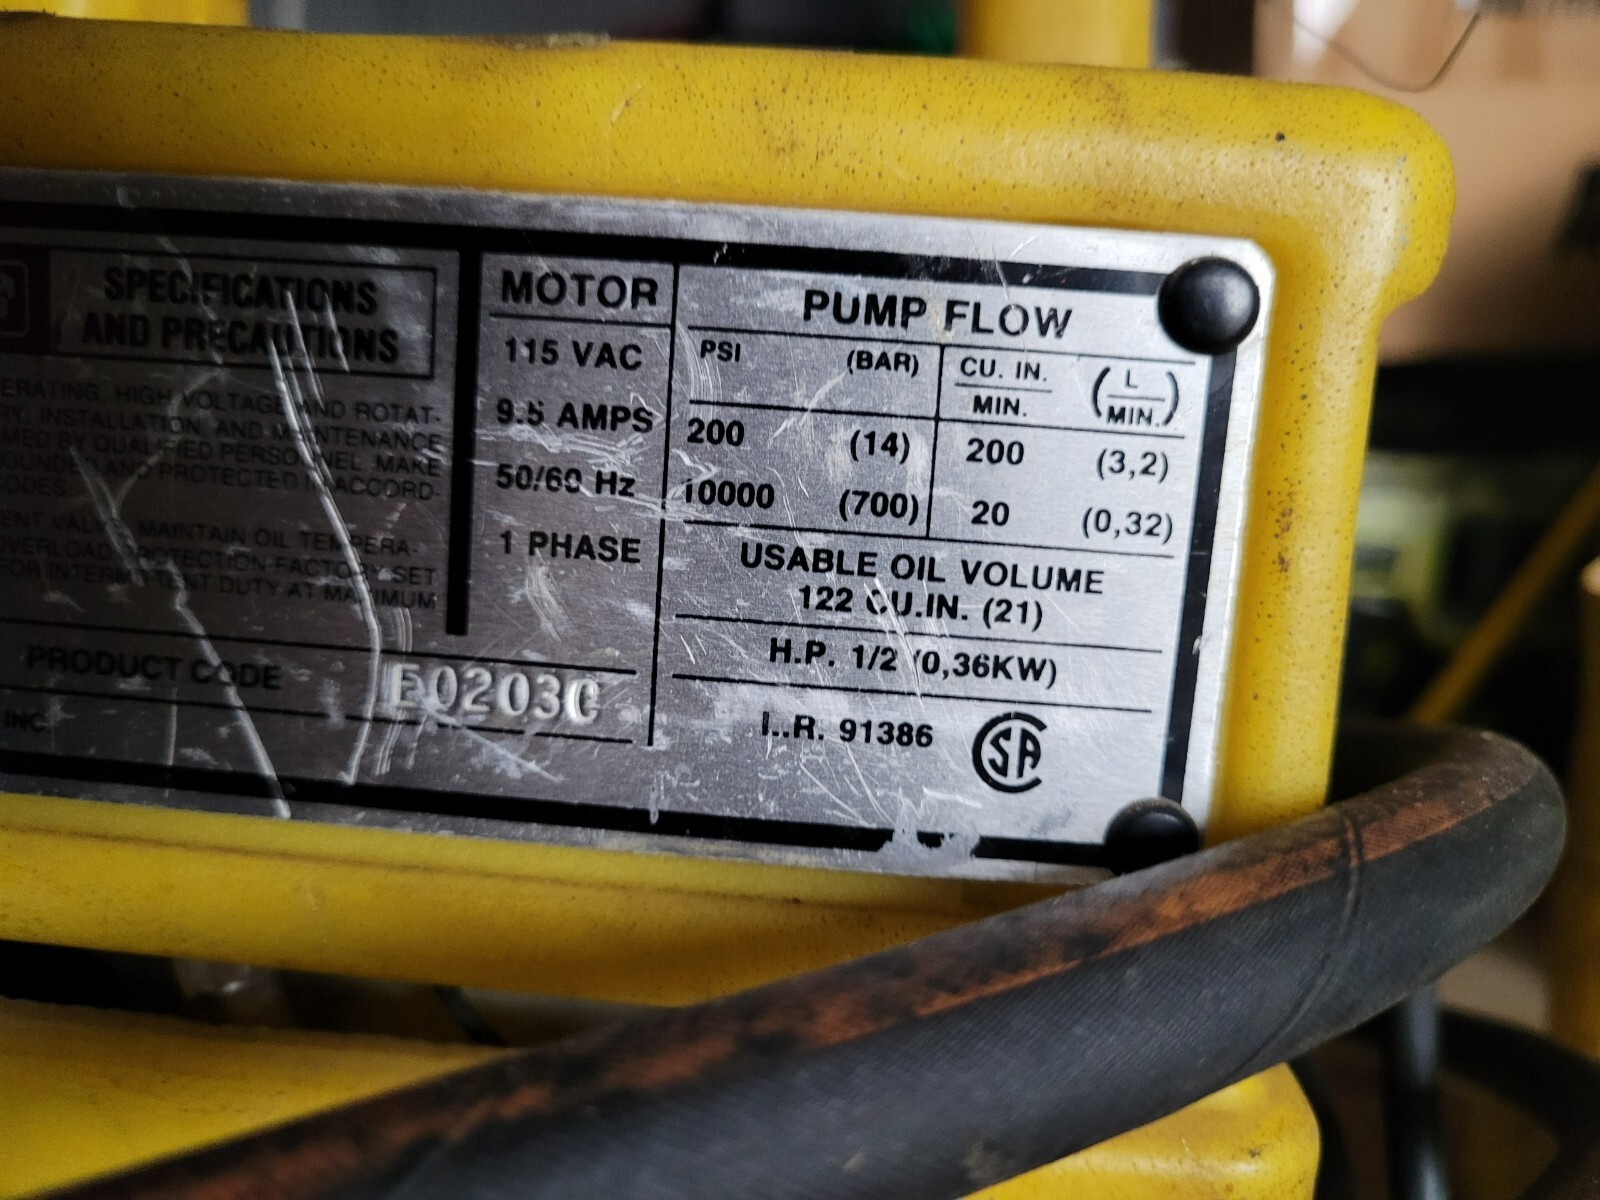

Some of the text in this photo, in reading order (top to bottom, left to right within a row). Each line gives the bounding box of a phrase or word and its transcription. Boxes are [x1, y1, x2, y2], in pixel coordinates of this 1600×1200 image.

[104, 266, 378, 315] SPECIFICATIONS
[501, 271, 658, 310] MOTOR
[803, 289, 1073, 339] PUMP FLOW
[82, 312, 399, 363] AND PRECAUTIONS
[505, 337, 642, 370] 115 VAC
[699, 340, 741, 362] PSI
[846, 349, 920, 377] (BAR)
[959, 357, 1047, 381] CU. IN.
[115, 385, 172, 407] HIGH
[182, 389, 288, 416] VOLTAGE
[355, 402, 440, 424] ROTAT-
[497, 398, 654, 434] 9.5 AMPS
[972, 395, 1027, 417] MIN.
[40, 407, 201, 435] INSTALLATION
[216, 418, 263, 440] AND
[272, 423, 441, 454] MNTENANCE
[687, 419, 911, 464] 200 (14)
[58, 430, 88, 452] BY
[221, 442, 362, 472] PERSONEL
[966, 438, 1170, 484] 200 (3,2)
[334, 476, 440, 500] ACCORD-
[496, 463, 636, 498] 50/60 Hz
[684, 480, 919, 526] 10000 (700)
[971, 501, 1174, 544] 20 (0,32)
[499, 531, 641, 564] 1 PHASE
[740, 542, 1104, 594] USABLE OIL VOLUME
[324, 584, 436, 610] MAIMUM
[799, 585, 853, 613] 122
[27, 644, 283, 691] PRODUCT CODE
[769, 638, 836, 668] H.P.
[852, 644, 898, 672] 1/2
[839, 719, 933, 748] 91386
